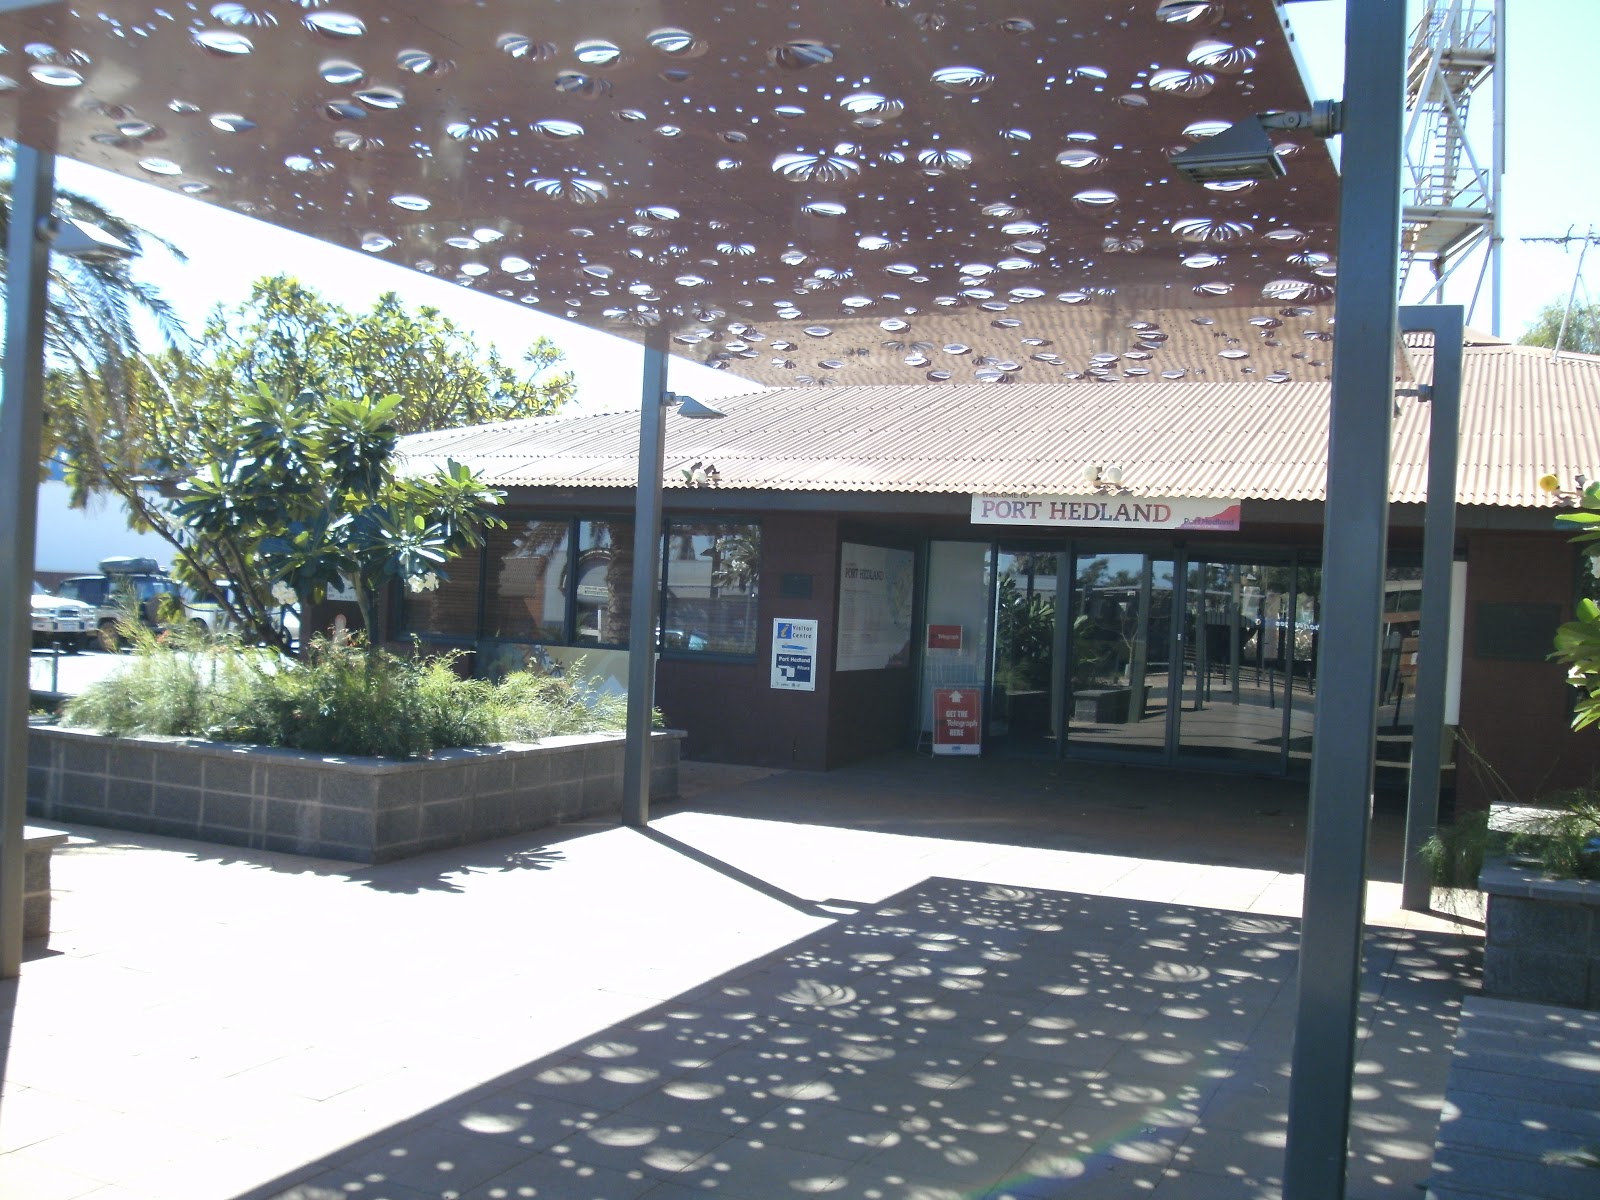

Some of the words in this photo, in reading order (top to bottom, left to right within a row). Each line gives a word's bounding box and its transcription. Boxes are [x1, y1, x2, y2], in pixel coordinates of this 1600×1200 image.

[981, 500, 1042, 519] PORT
[1049, 501, 1172, 523] HEDLAND
[945, 710, 957, 718] GET
[957, 710, 969, 718] THE
[946, 719, 978, 728] Telegraph
[949, 729, 964, 737] HERE
